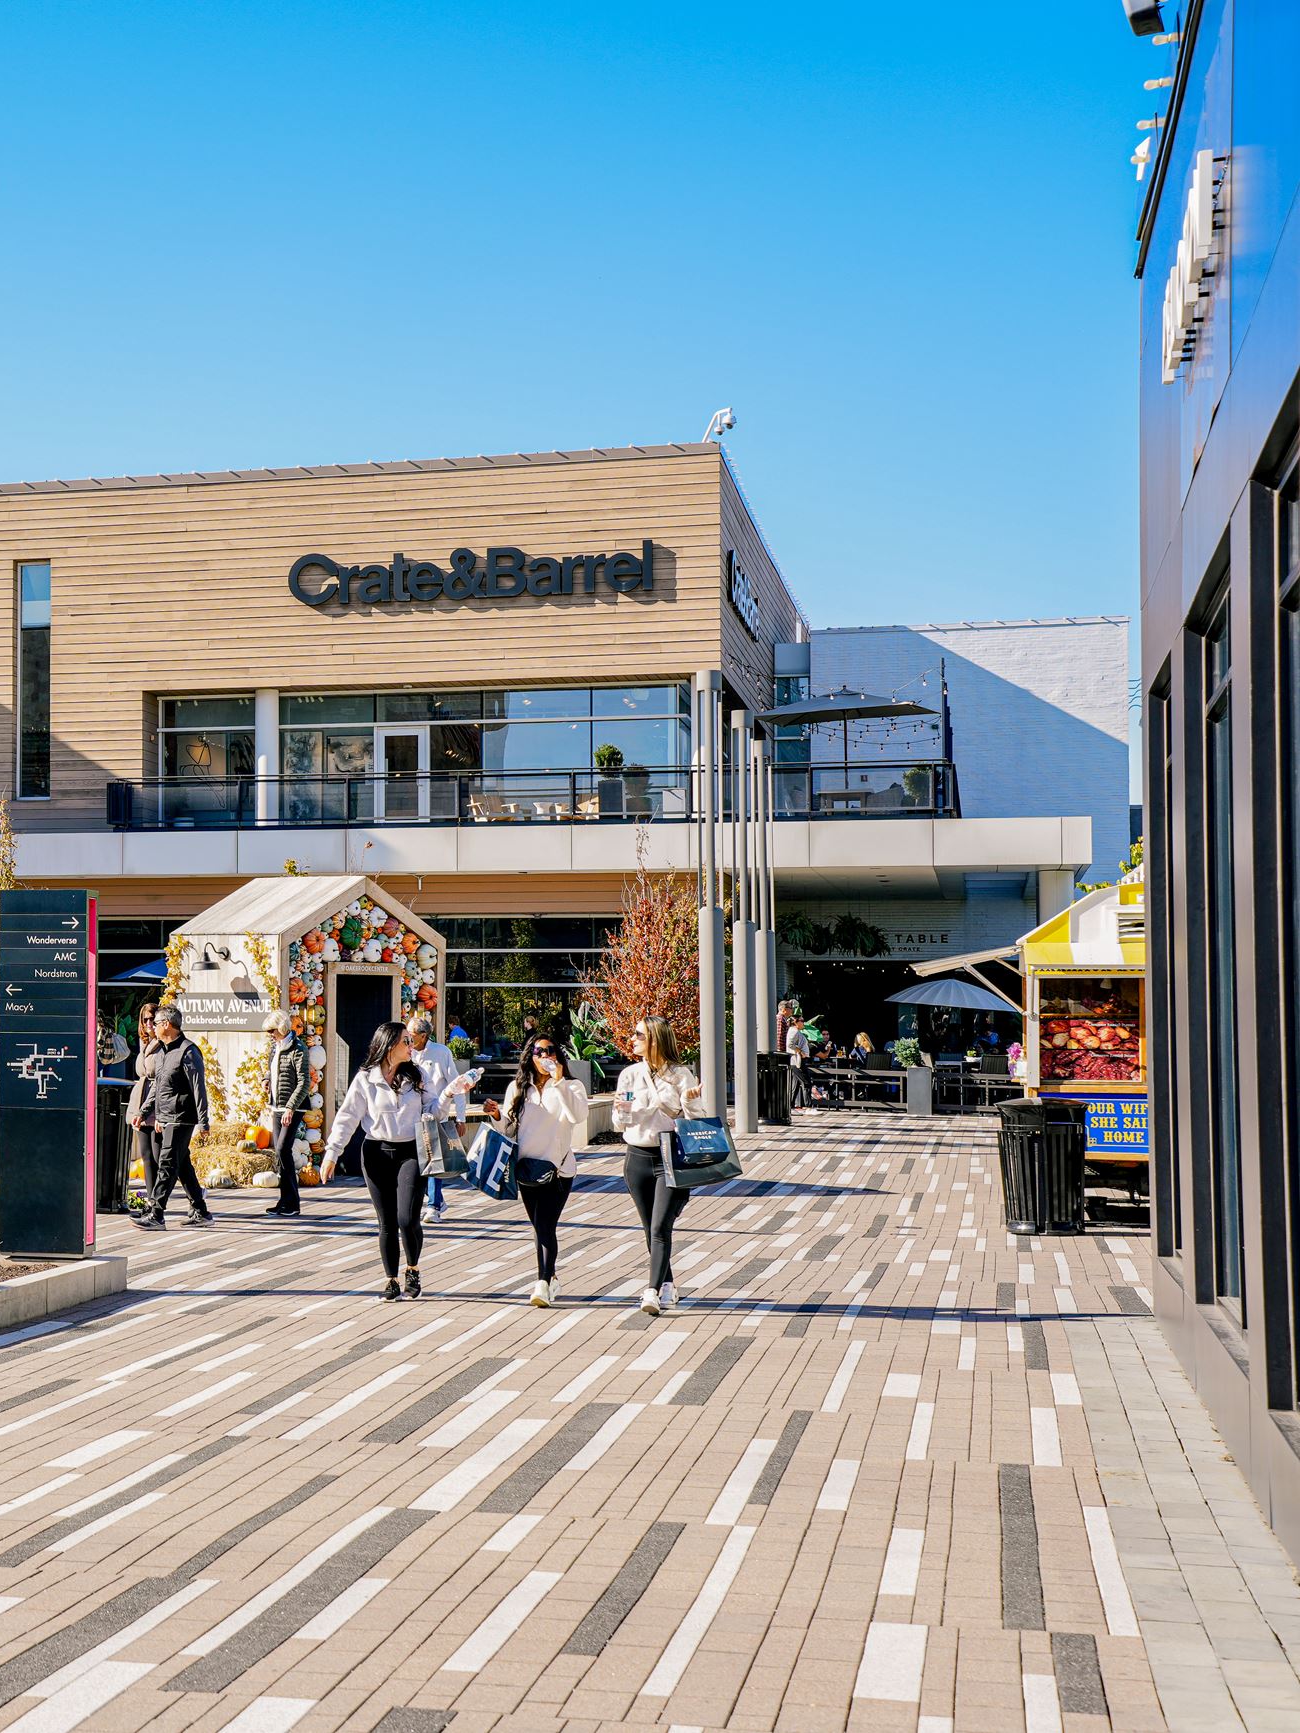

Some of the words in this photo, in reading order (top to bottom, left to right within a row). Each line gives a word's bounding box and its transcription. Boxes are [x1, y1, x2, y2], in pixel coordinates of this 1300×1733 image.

[288, 539, 653, 605] Crate&Barrel
[26, 935, 78, 945] Wonderverse
[895, 934, 949, 944] TABLE
[53, 952, 77, 962] AMC
[34, 968, 78, 978] Nordstrom
[5, 1002, 34, 1013] Macy's
[177, 999, 224, 1013] AUTUMN
[227, 999, 271, 1013] AVENUE
[185, 1015, 222, 1025] Oakbrook
[223, 1016, 248, 1025] Center
[1090, 1117, 1118, 1128] SHE
[1103, 1131, 1144, 1143] HOME
